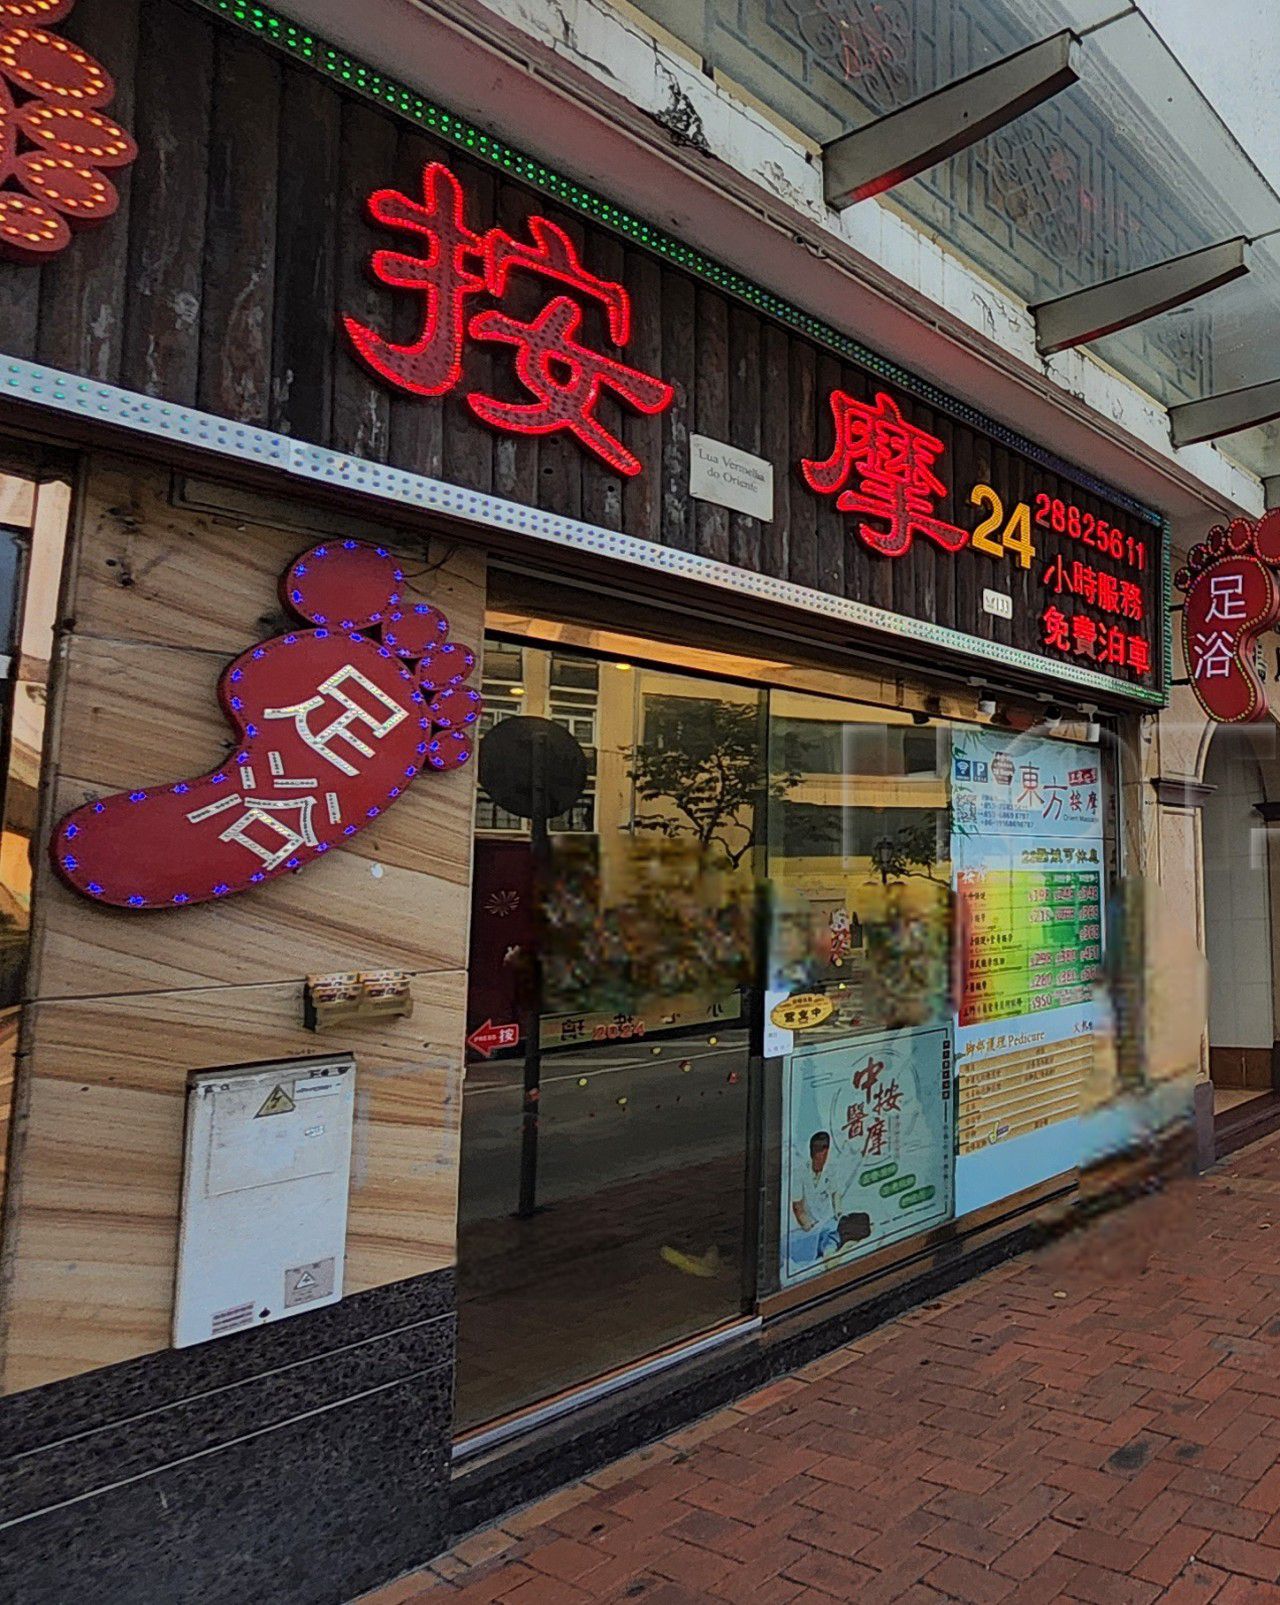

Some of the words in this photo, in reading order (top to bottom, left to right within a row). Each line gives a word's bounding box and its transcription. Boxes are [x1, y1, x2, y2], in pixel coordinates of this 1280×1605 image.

[699, 448, 718, 463] Lua
[706, 467, 720, 479] do
[722, 472, 758, 494] Oriente
[970, 483, 1036, 570] 24
[1036, 493, 1146, 571] 28825611
[1043, 554, 1144, 622] 小時服務
[1043, 605, 1150, 675] 免費泊車
[1194, 574, 1248, 680] 足浴
[187, 663, 410, 871] 足浴
[1017, 761, 1069, 821] 東方
[1069, 789, 1097, 815] 按摩
[473, 1034, 498, 1043] PRESS
[499, 1028, 513, 1043] 按
[1008, 1031, 1045, 1047] Pedicure
